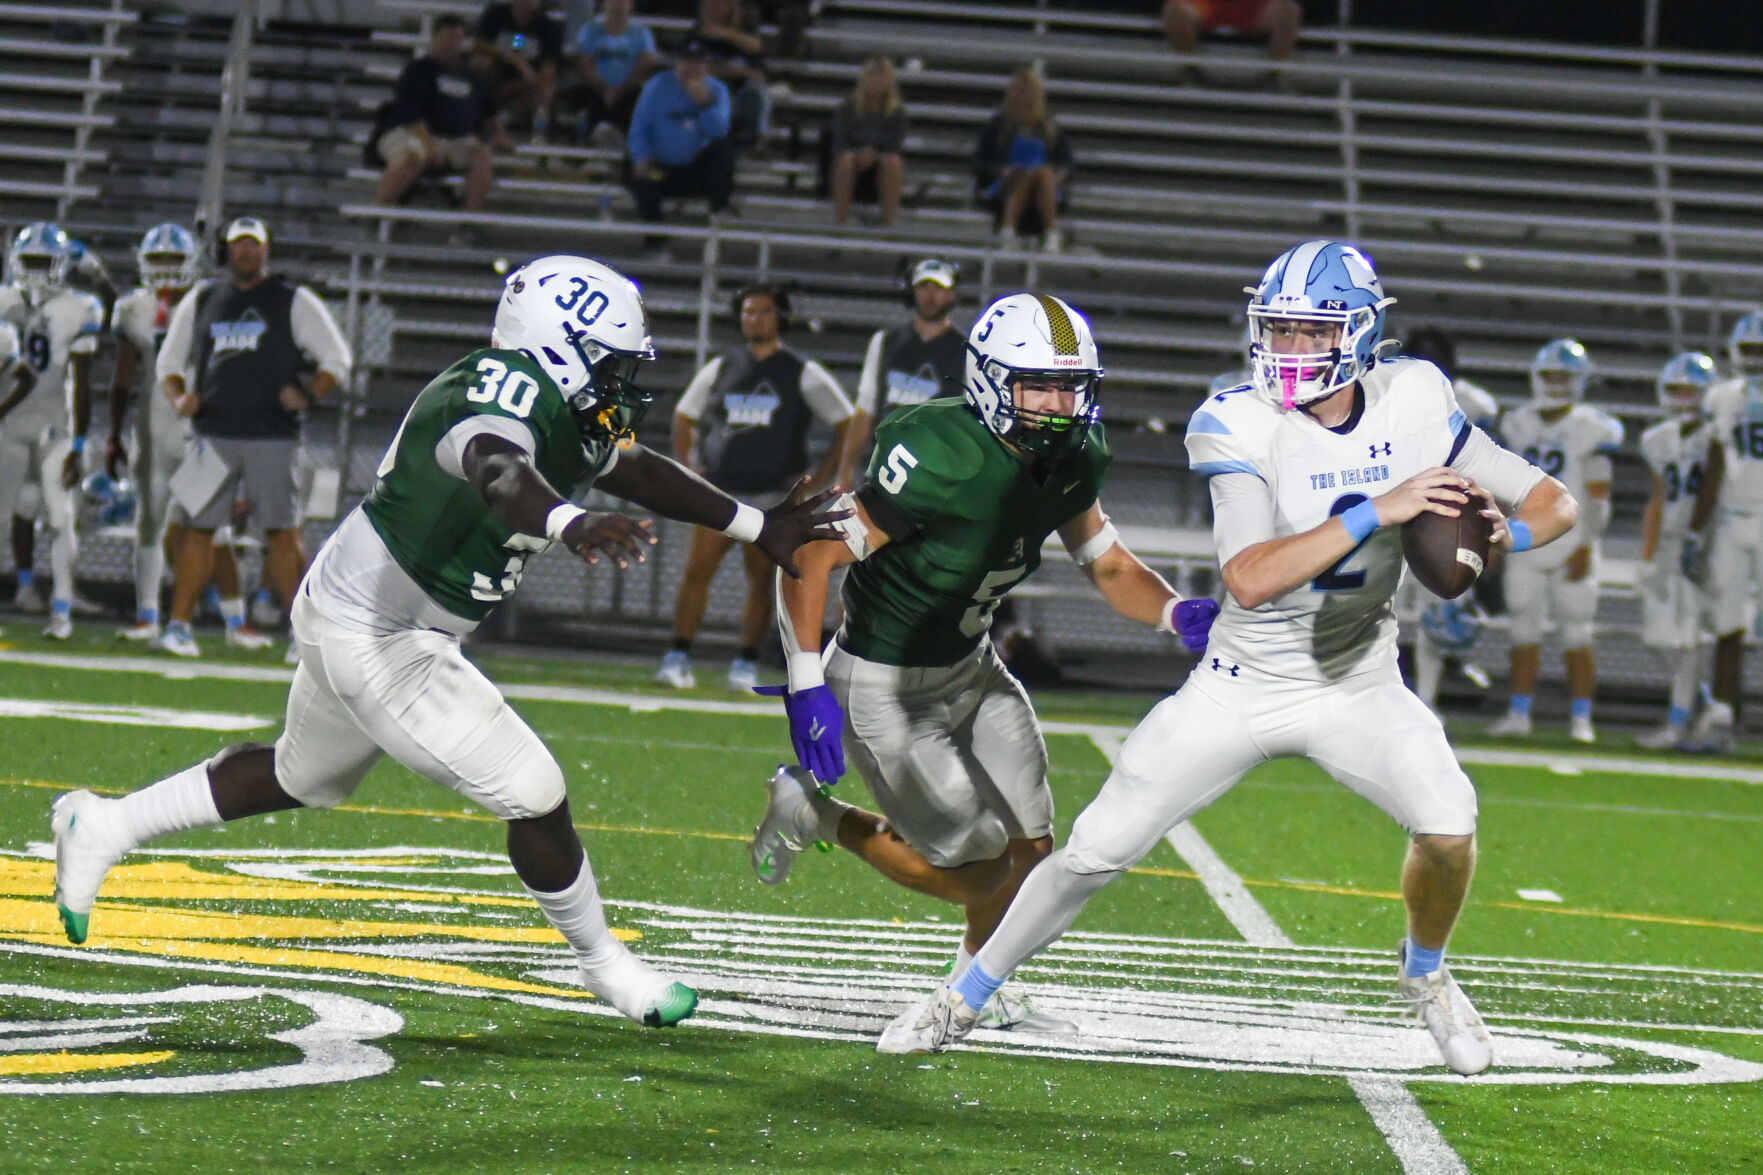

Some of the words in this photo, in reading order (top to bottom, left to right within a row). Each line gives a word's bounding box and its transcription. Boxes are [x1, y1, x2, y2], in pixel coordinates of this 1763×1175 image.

[554, 276, 609, 326] 30
[978, 309, 1006, 342] 5
[1053, 358, 1083, 367] Riddell
[466, 357, 540, 418] 30
[878, 443, 919, 495] 5
[1310, 472, 1336, 490] THE
[1341, 464, 1390, 486] ISLAND
